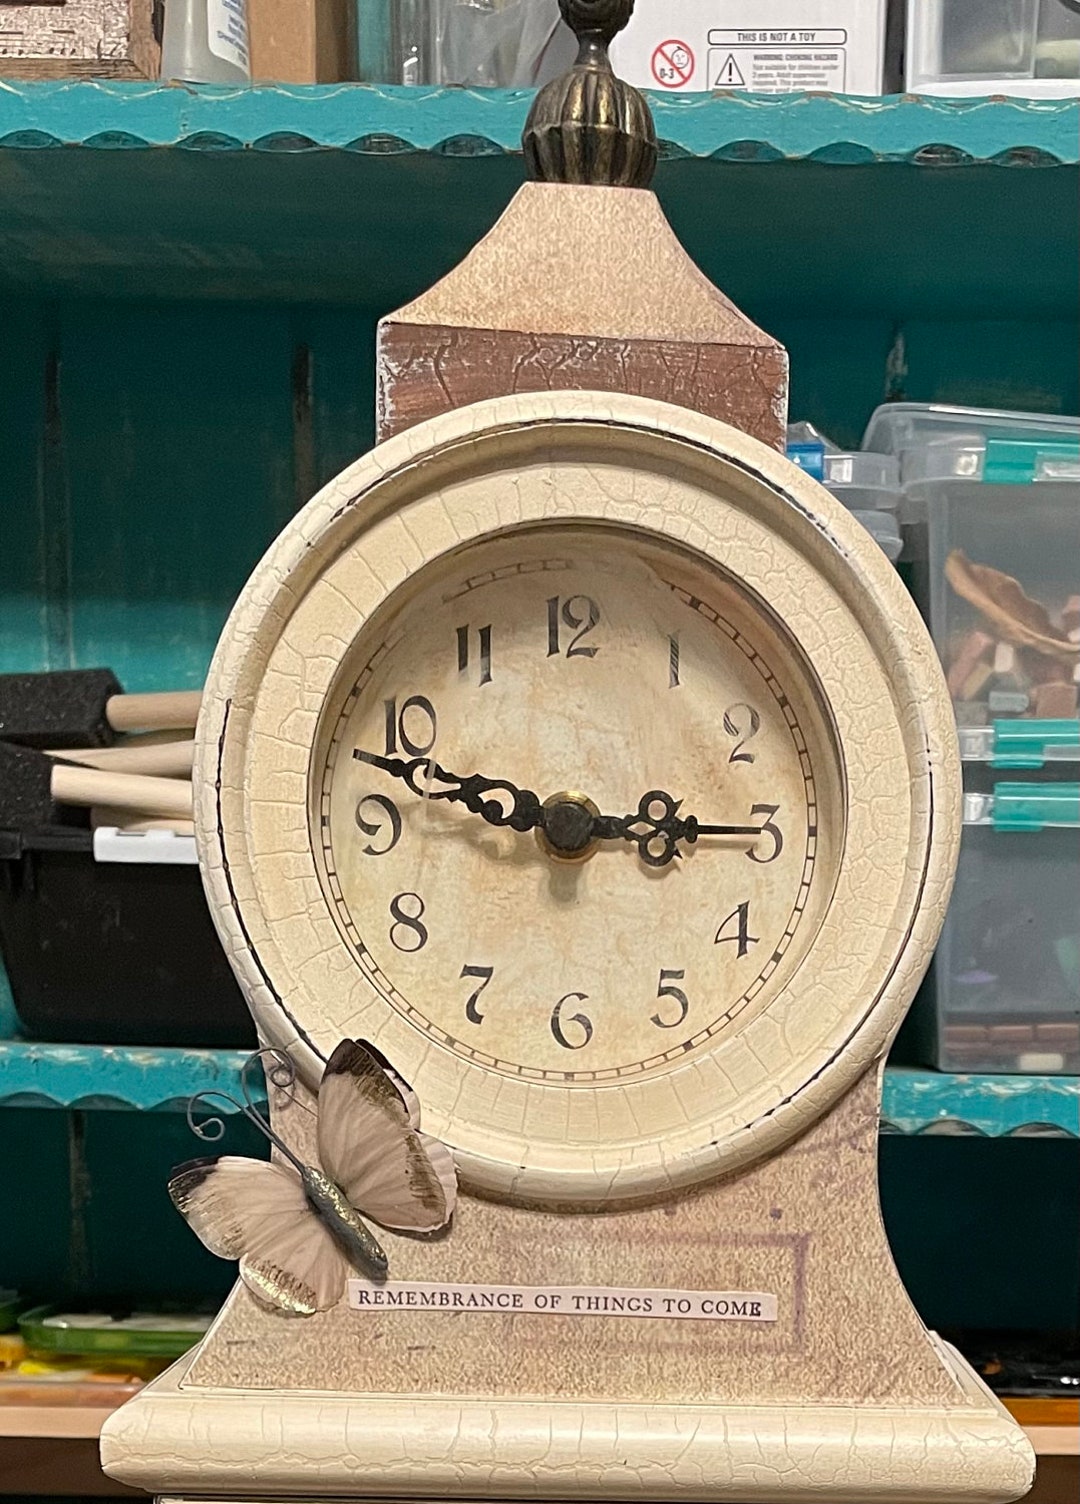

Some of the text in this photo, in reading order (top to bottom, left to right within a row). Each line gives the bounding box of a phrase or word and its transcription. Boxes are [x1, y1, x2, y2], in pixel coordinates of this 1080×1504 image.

[737, 33, 816, 42] THIS IS NOT A TOY
[659, 68, 675, 79] 0-3
[455, 623, 493, 687] 11
[545, 594, 601, 659] 12
[666, 630, 681, 689] 1
[383, 694, 437, 758] 10
[722, 702, 761, 764] 2
[354, 793, 403, 856] 9
[744, 803, 784, 864] 3
[388, 892, 428, 953] 8
[713, 899, 761, 960] 4
[459, 964, 495, 1026] 7
[550, 991, 594, 1050] 6
[649, 968, 690, 1029] 5
[357, 1290, 762, 1317] REMEMBRANCE OF THINGS TO COME
